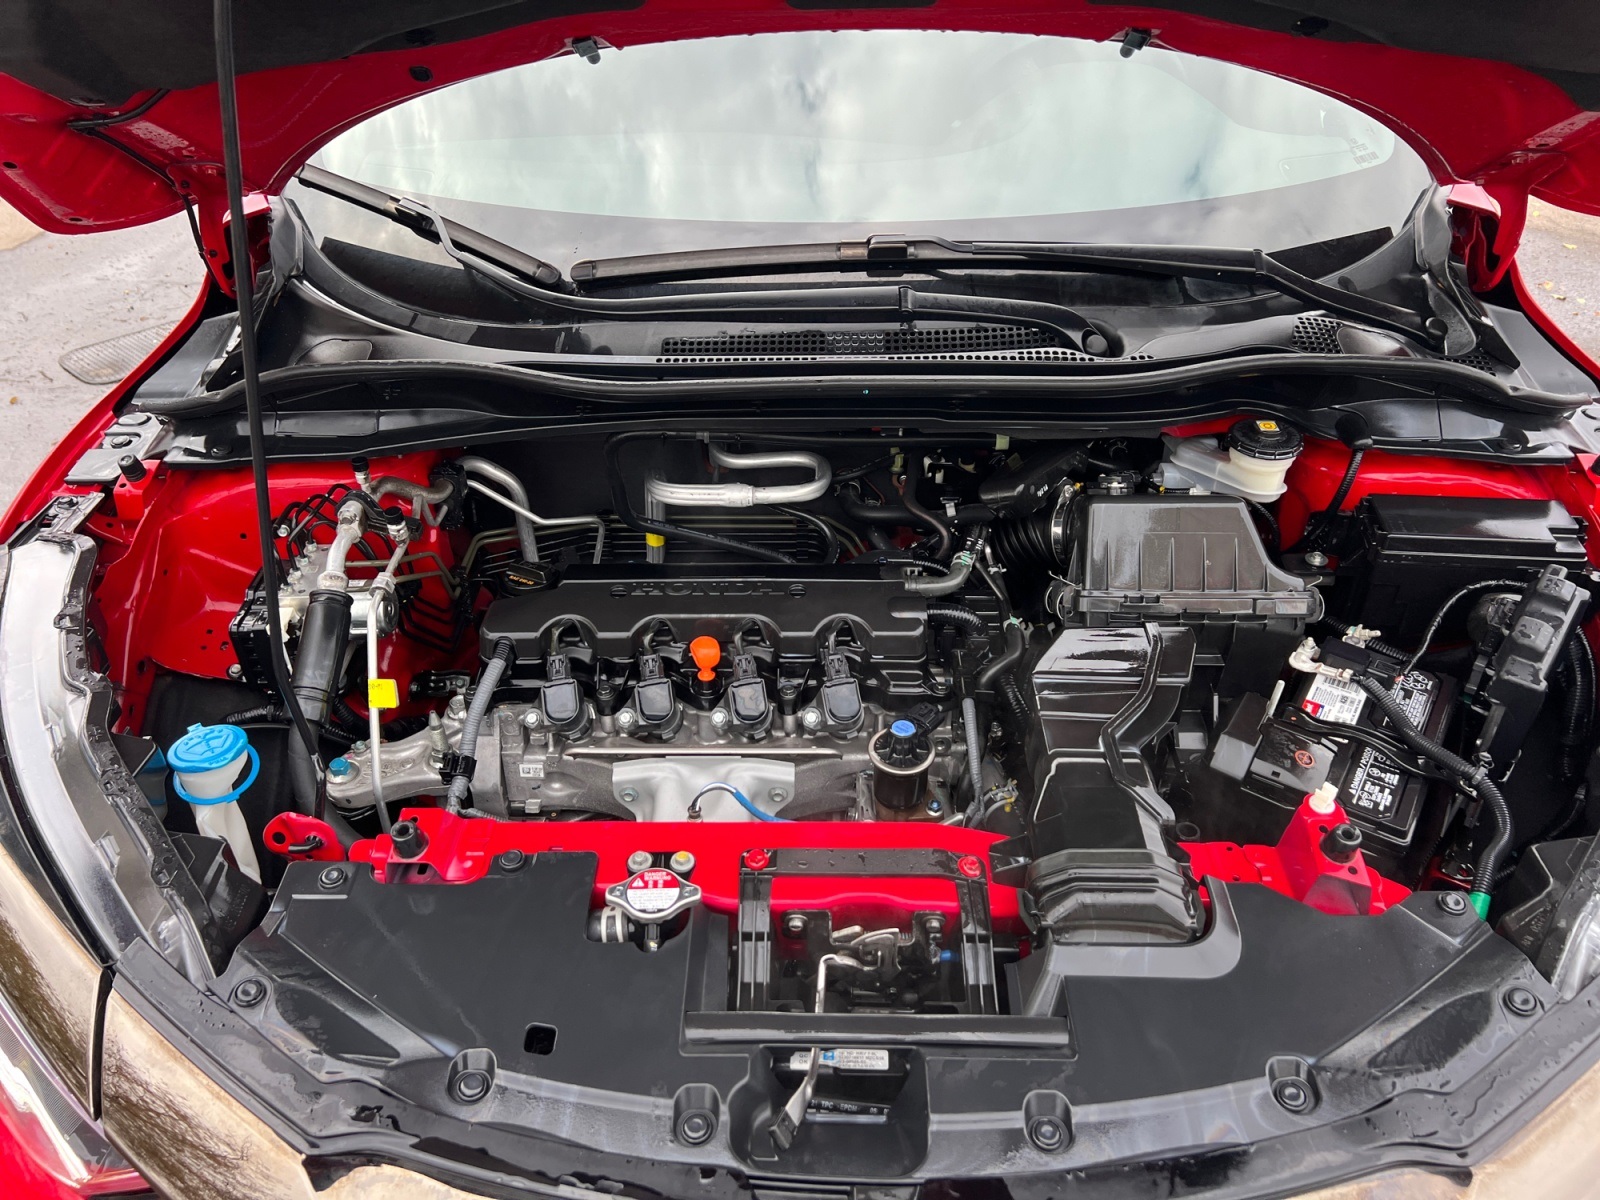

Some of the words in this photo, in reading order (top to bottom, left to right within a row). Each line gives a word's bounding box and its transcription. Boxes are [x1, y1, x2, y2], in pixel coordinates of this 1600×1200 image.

[631, 582, 785, 595] HONDA
[1350, 767, 1365, 790] DANGER
[821, 1101, 834, 1109] TPC
